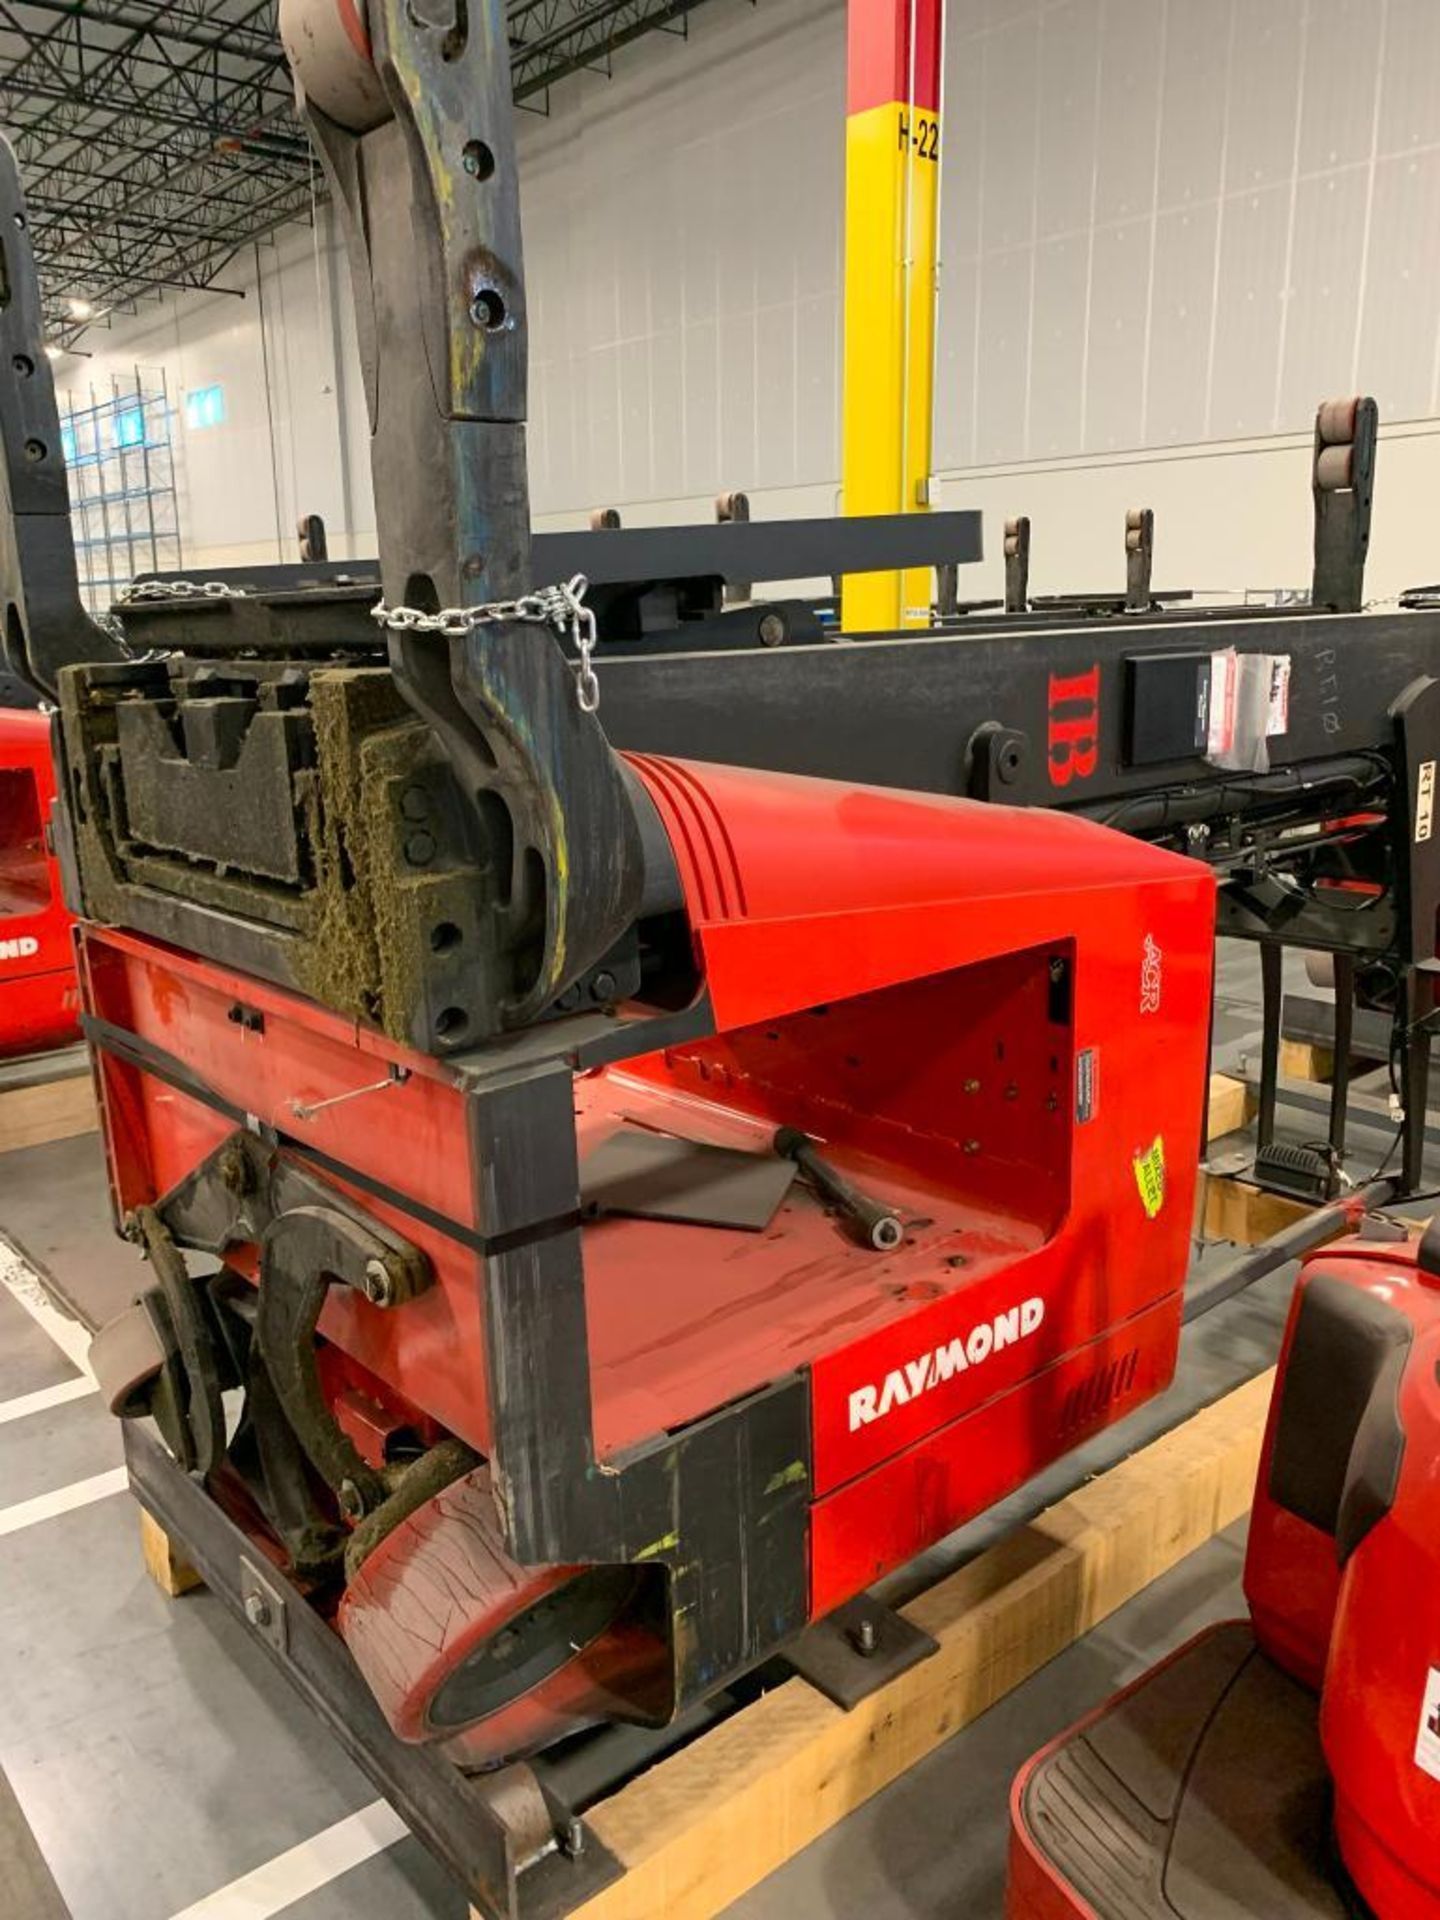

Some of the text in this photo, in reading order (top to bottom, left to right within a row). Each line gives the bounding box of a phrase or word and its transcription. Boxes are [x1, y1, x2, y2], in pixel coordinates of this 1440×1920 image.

[1418, 764, 1433, 838] RT 10
[848, 1297, 1045, 1433] RAYMOND
